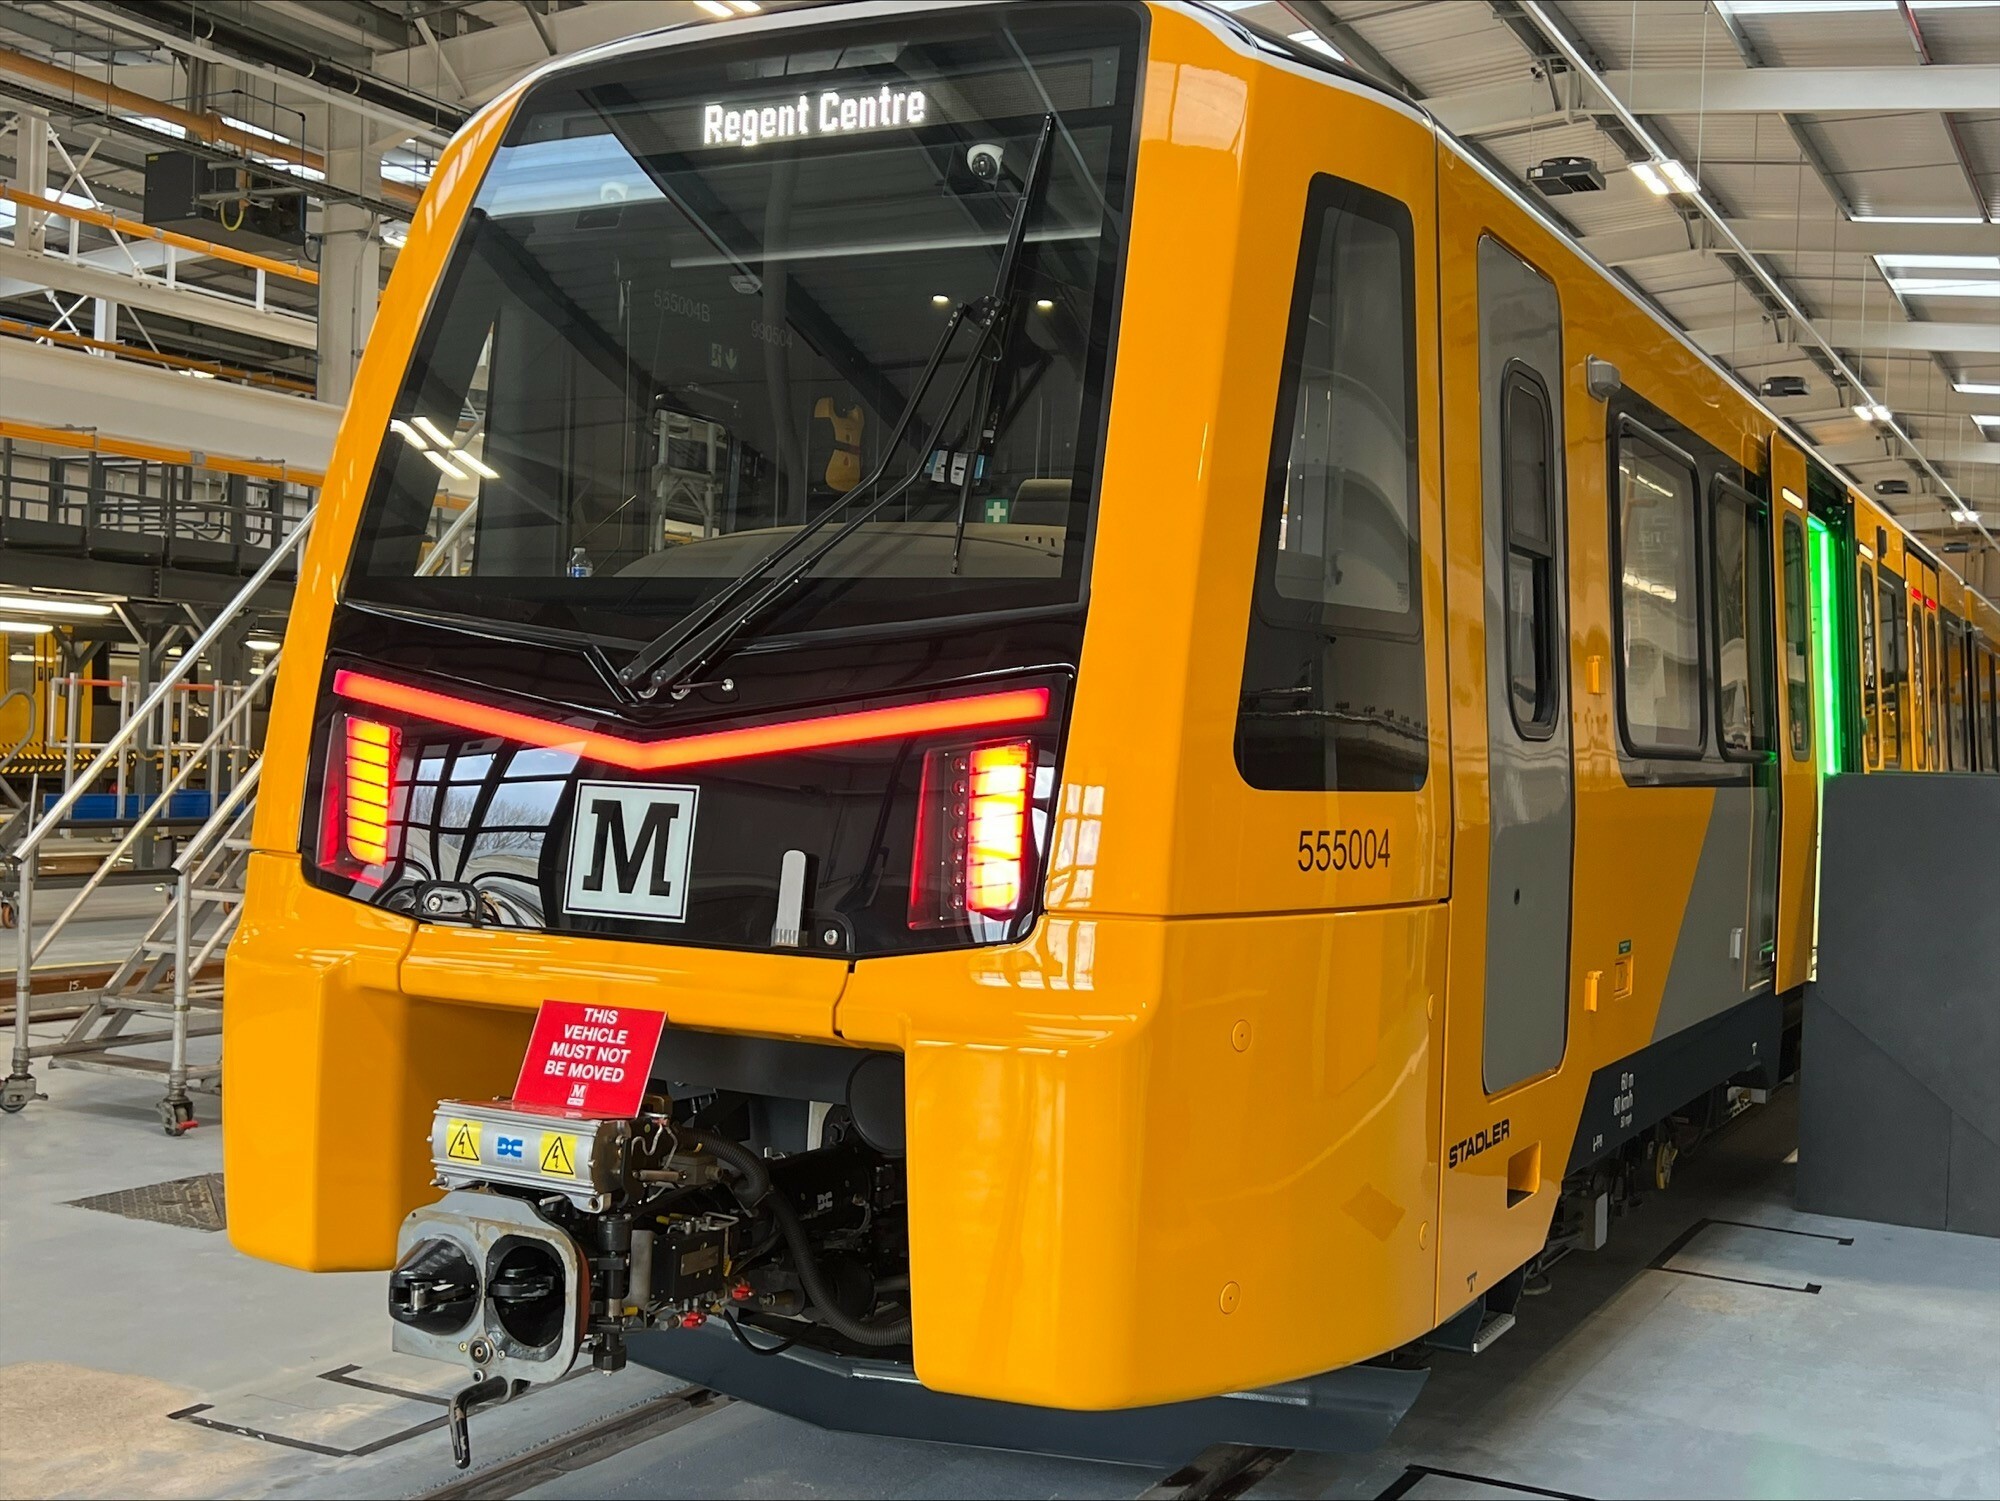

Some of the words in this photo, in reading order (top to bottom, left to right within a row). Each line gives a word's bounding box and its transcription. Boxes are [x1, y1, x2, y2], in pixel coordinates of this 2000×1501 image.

[704, 95, 809, 147] Regent
[819, 85, 926, 132] Centre
[654, 289, 711, 322] 555004B
[582, 798, 680, 897] M
[1298, 828, 1391, 872] 555004
[584, 1007, 618, 1025] THIS
[564, 1024, 628, 1045] VEHICLE
[550, 1042, 595, 1060] MUST
[596, 1047, 631, 1065] NOT
[544, 1060, 566, 1077] BE
[567, 1063, 624, 1083] MOVED
[570, 1084, 587, 1098] M
[1449, 1118, 1510, 1169] STADLER
